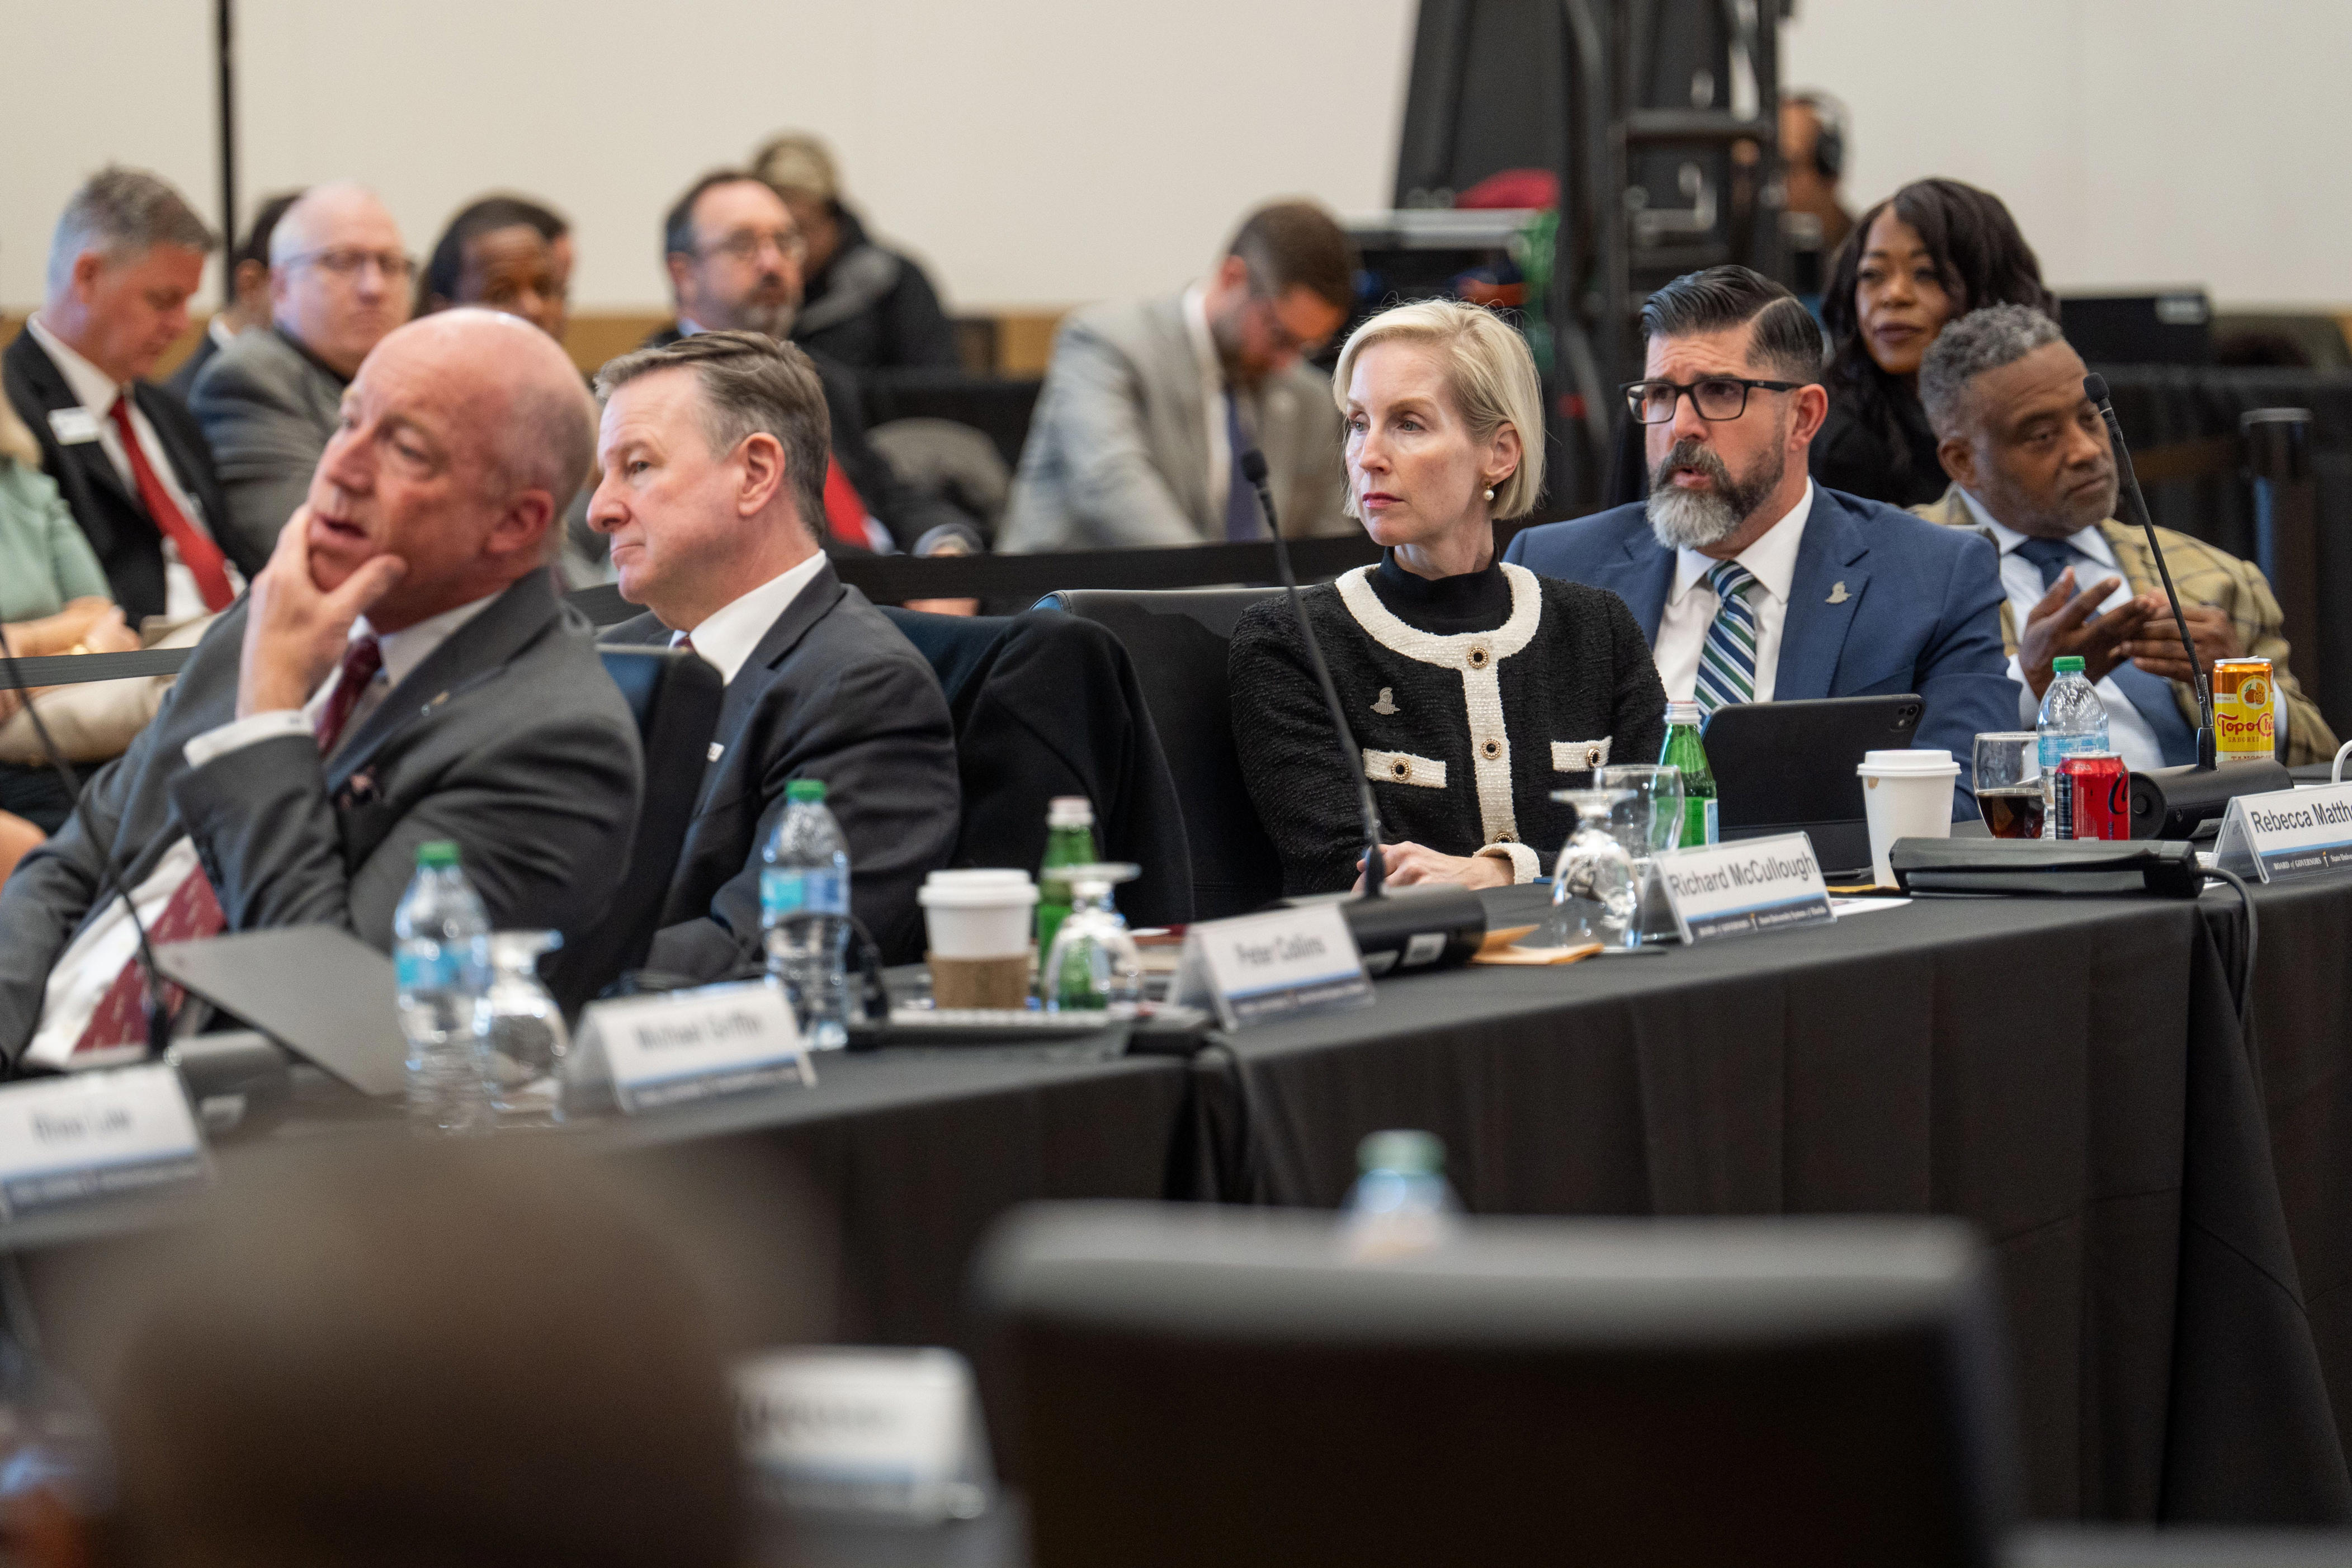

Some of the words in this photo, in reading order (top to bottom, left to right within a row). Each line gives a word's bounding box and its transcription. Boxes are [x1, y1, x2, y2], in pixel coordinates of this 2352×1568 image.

[2217, 712, 2258, 737] Topo
[2250, 810, 2313, 833] Rebecca
[2311, 800, 2352, 825] Matth
[1669, 866, 1729, 896] Richard
[1728, 851, 1816, 887] McCullough
[2273, 861, 2290, 870] BOARD
[2294, 857, 2322, 867] GOVERNORS
